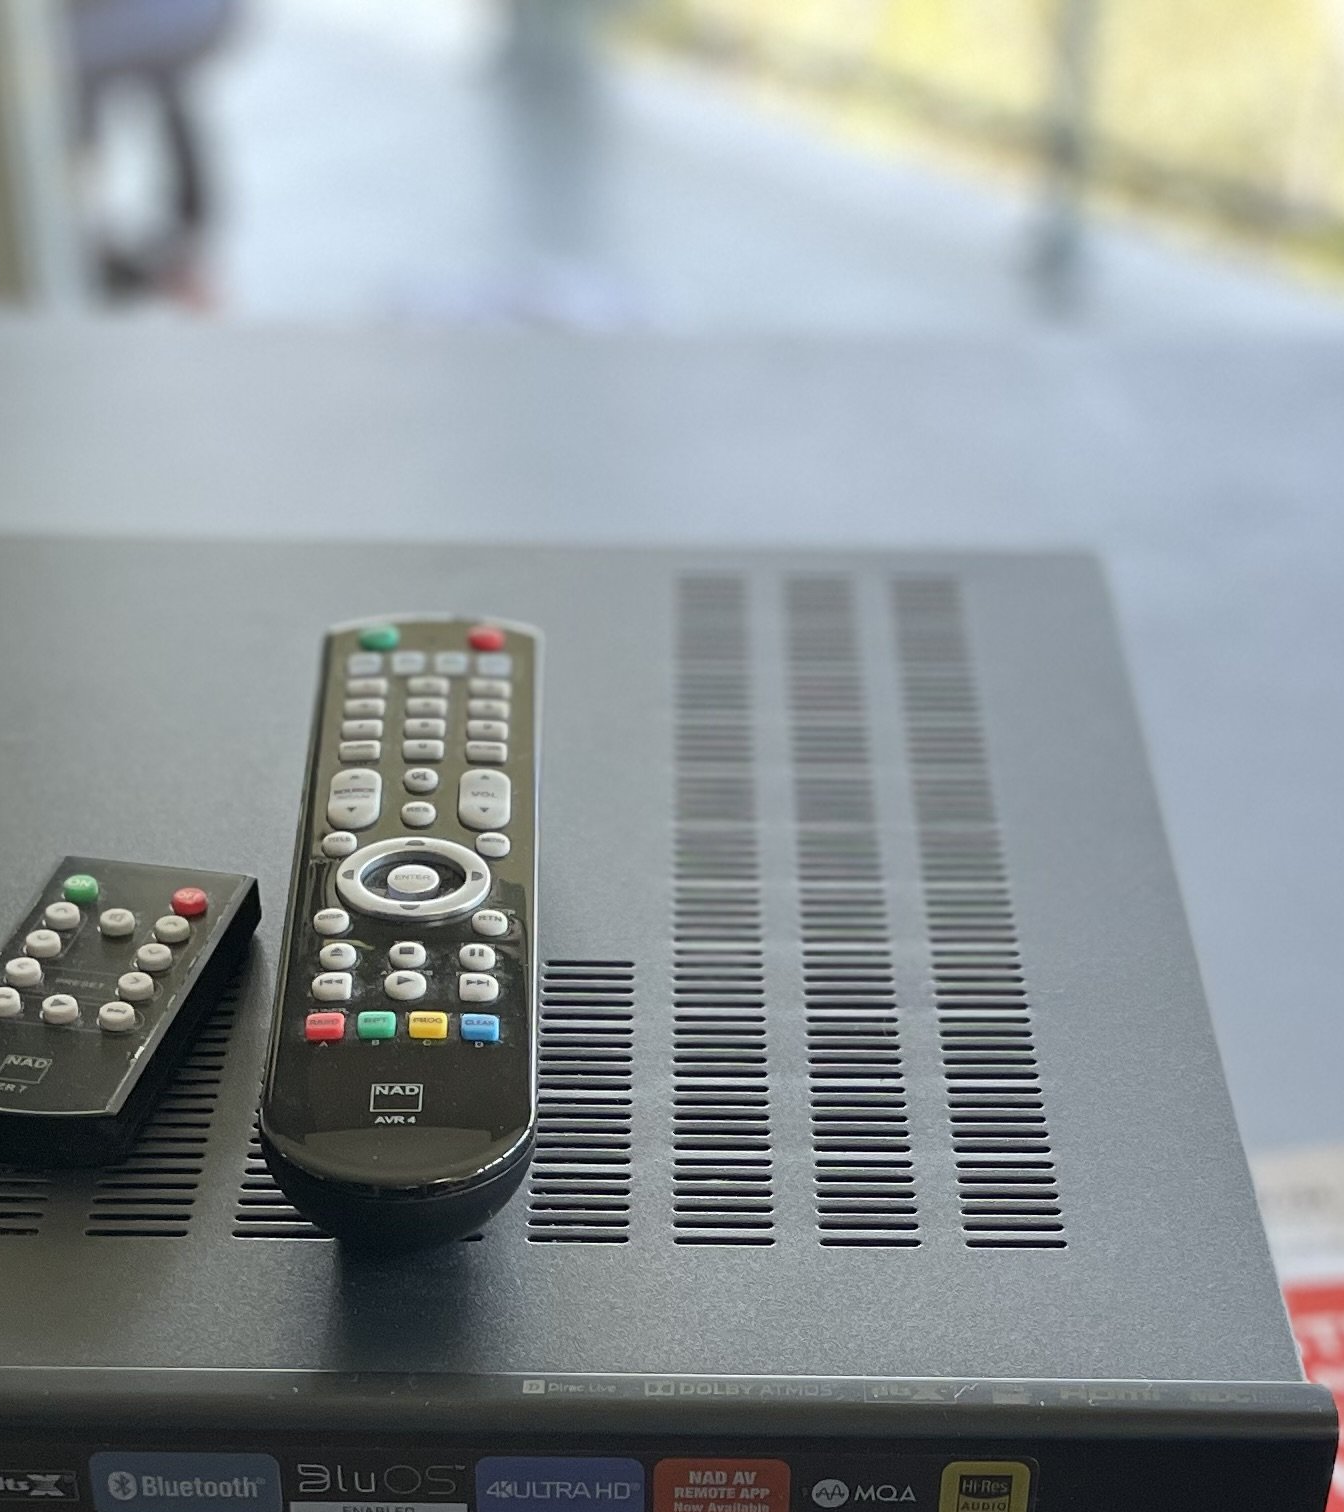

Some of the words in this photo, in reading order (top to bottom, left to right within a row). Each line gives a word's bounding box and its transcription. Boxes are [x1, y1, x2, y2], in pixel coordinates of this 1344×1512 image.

[68, 878, 91, 888] ON
[7, 1055, 47, 1069] NAD
[374, 1085, 419, 1096] NAD
[374, 1115, 405, 1124] AVR
[407, 1115, 417, 1124] 4
[679, 1382, 753, 1395] DOLBY
[760, 1383, 833, 1396] ATMOS
[688, 1470, 728, 1485] NAD
[731, 1470, 757, 1485] AV
[141, 1475, 260, 1499] Bluetooth
[674, 1487, 737, 1499] REMOTE
[739, 1487, 770, 1499] APP
[854, 1485, 917, 1502] MQA
[673, 1502, 705, 1512] Now
[961, 1501, 1007, 1512] AUDIO
